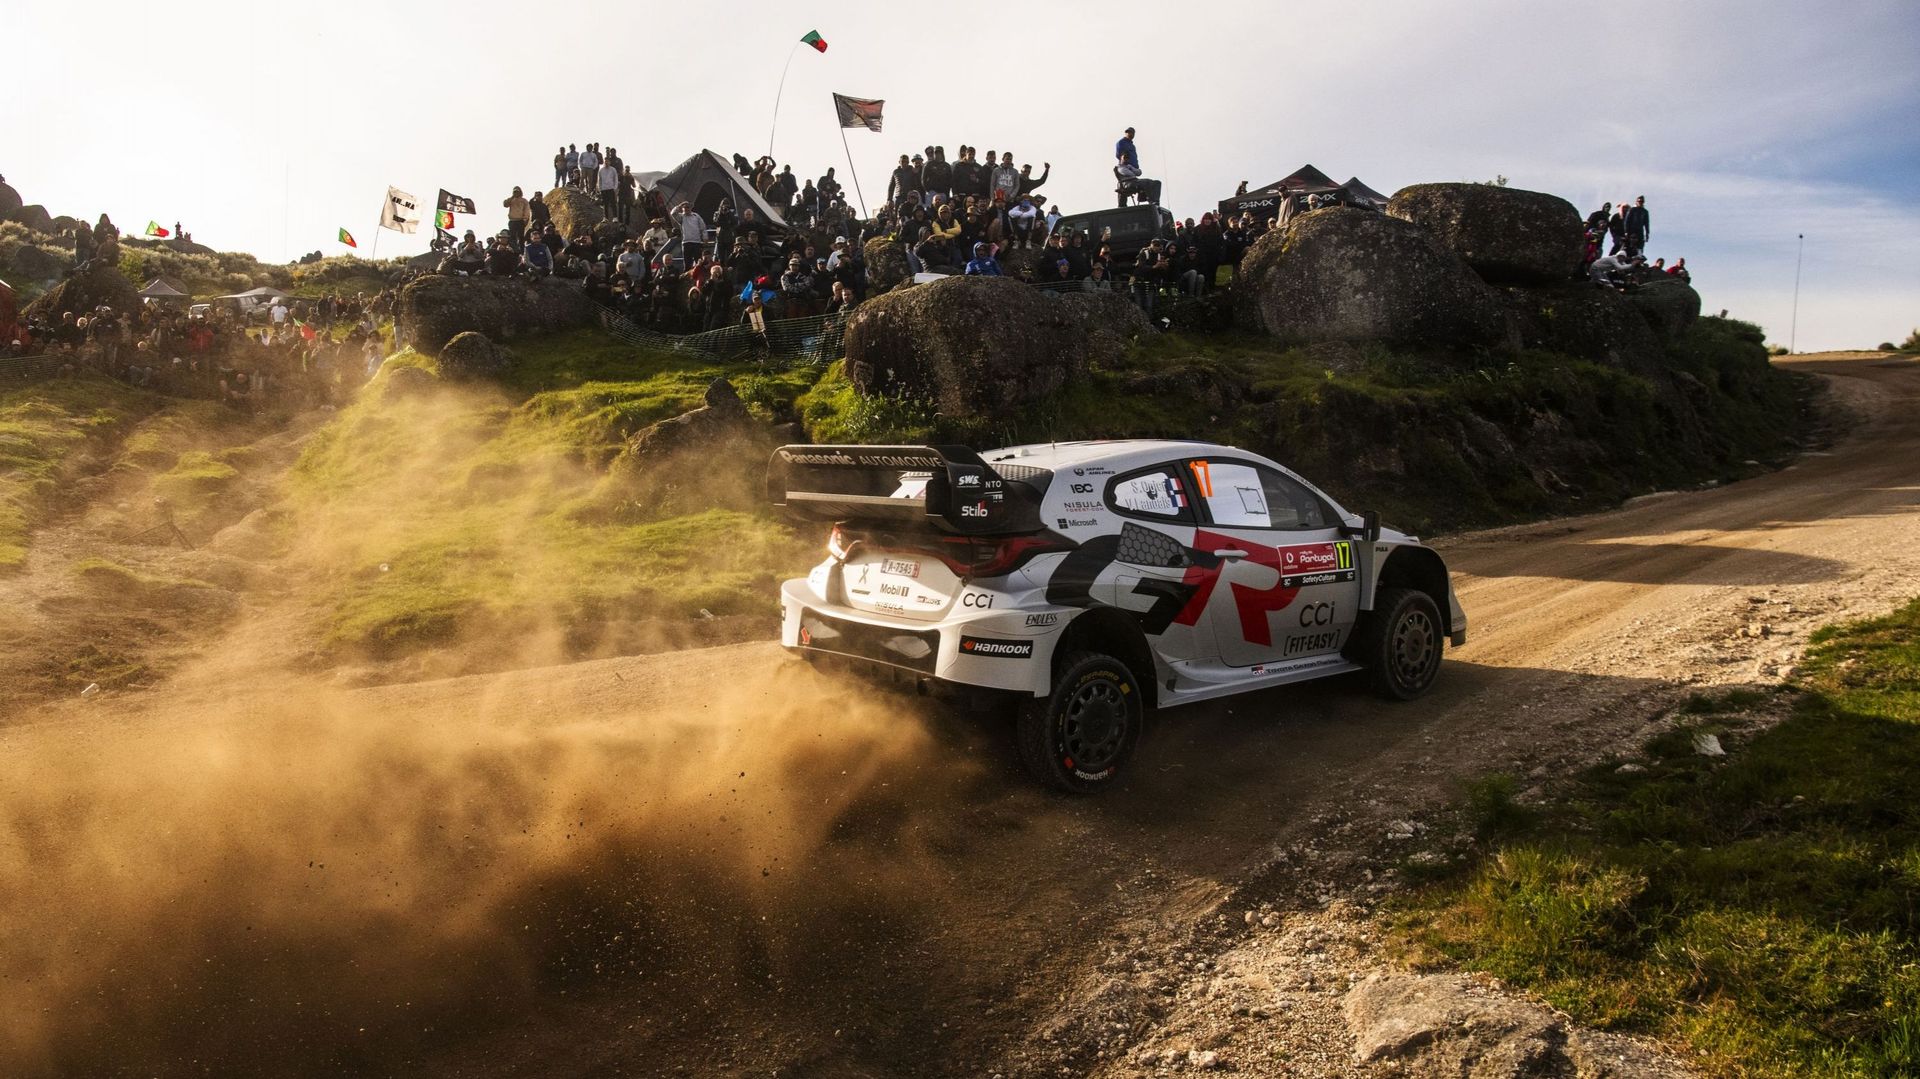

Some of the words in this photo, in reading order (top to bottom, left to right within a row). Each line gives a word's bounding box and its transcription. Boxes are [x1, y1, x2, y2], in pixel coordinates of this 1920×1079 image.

[1238, 199, 1274, 209] 24MX
[779, 451, 856, 465] Panasonic
[858, 456, 945, 468] AUTOMOTIVE
[958, 475, 980, 485] SWS
[1189, 460, 1213, 498] 17
[961, 502, 988, 517] Stilo
[1068, 519, 1098, 527] Microsoft
[1300, 553, 1335, 563] Portugal
[1336, 542, 1350, 569] 17
[888, 561, 913, 574] A-7545
[1302, 574, 1336, 584] SafetyCulture
[880, 583, 901, 596] Mobil
[901, 587, 909, 597] 1
[1025, 613, 1058, 625] ENDLESS
